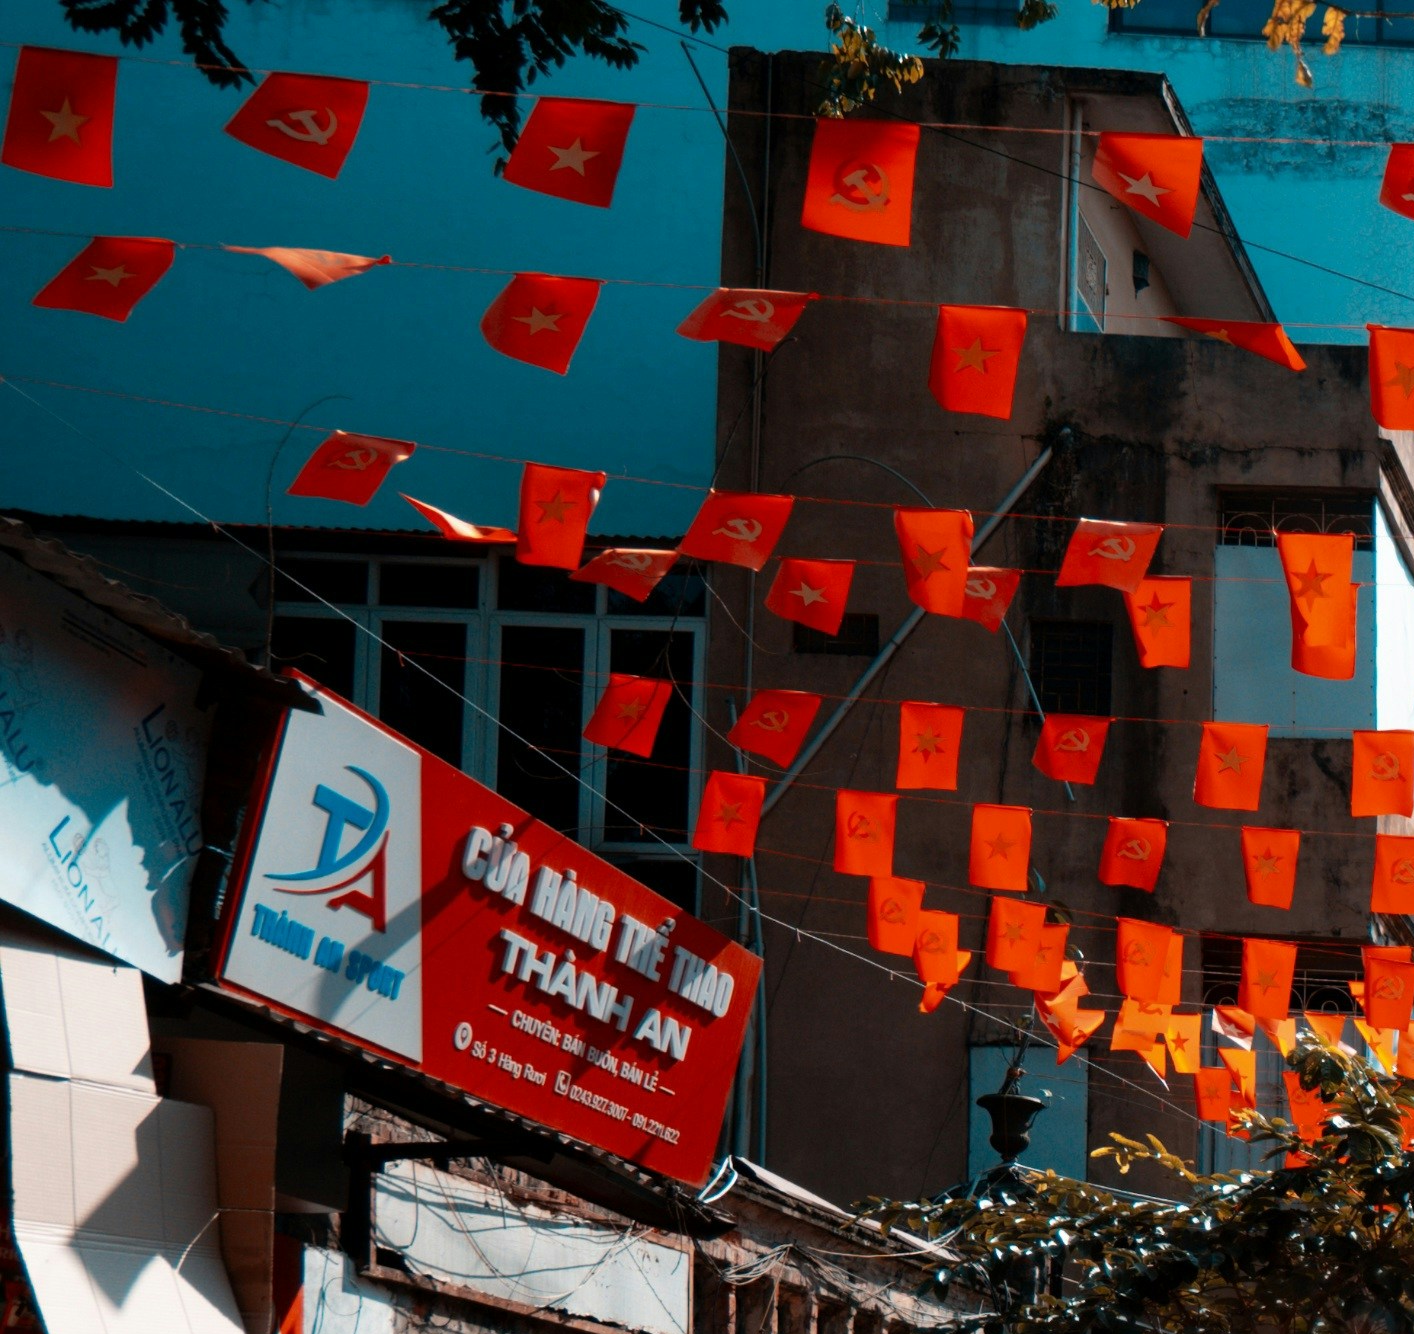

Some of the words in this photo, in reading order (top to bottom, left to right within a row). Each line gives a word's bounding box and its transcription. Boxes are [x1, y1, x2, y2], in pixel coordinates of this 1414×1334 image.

[461, 822, 531, 907] CỬA
[529, 864, 617, 953] HÀNG
[614, 913, 677, 983] THỂ
[667, 944, 735, 1019] THAO
[344, 949, 406, 1002] SPORT
[499, 927, 635, 1033] THÀNH
[633, 1007, 693, 1062] AN
[471, 1040, 489, 1060] Số
[488, 1048, 498, 1065] 3
[497, 1051, 523, 1079] Hàng
[511, 1009, 562, 1047] CHUYÊN:
[561, 1033, 588, 1059] BÁN
[620, 1061, 644, 1086] BÁN
[642, 1070, 660, 1093] LẺ
